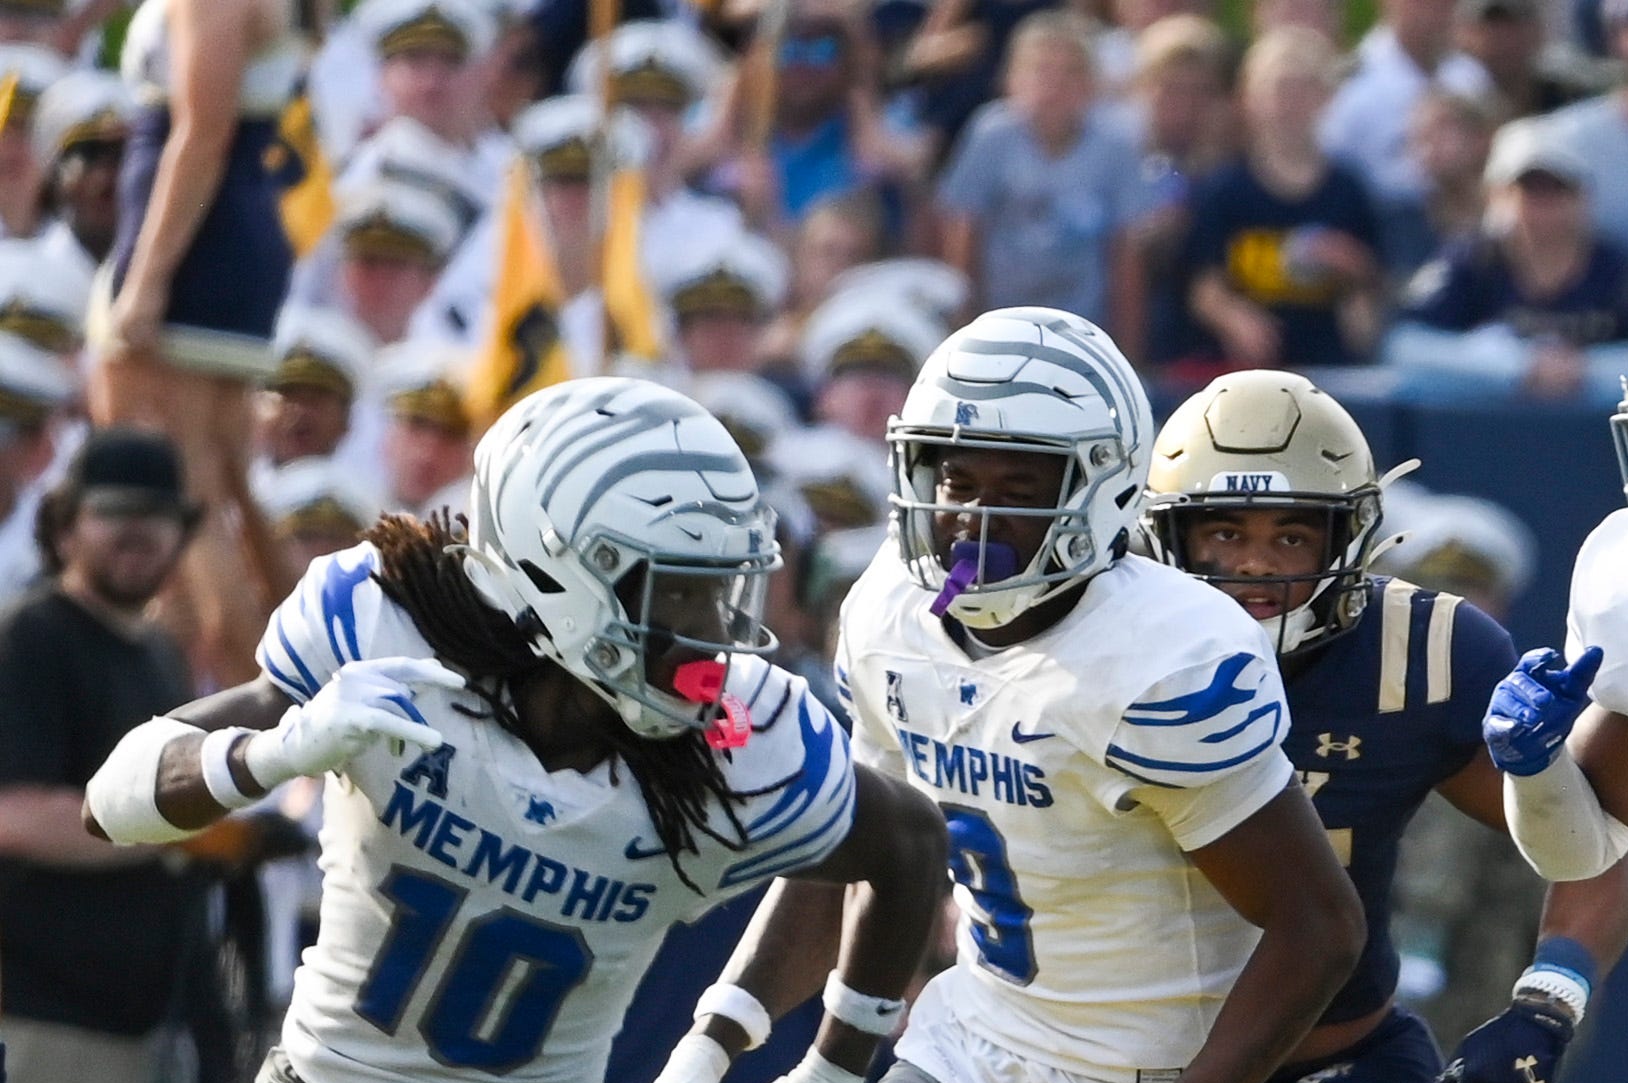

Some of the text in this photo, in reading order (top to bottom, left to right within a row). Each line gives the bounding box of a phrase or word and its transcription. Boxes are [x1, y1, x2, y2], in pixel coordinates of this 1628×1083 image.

[1226, 475, 1273, 492] NAVY
[378, 779, 657, 923] MEMPHIS
[938, 801, 1039, 988] 9
[354, 862, 596, 1077] 10
